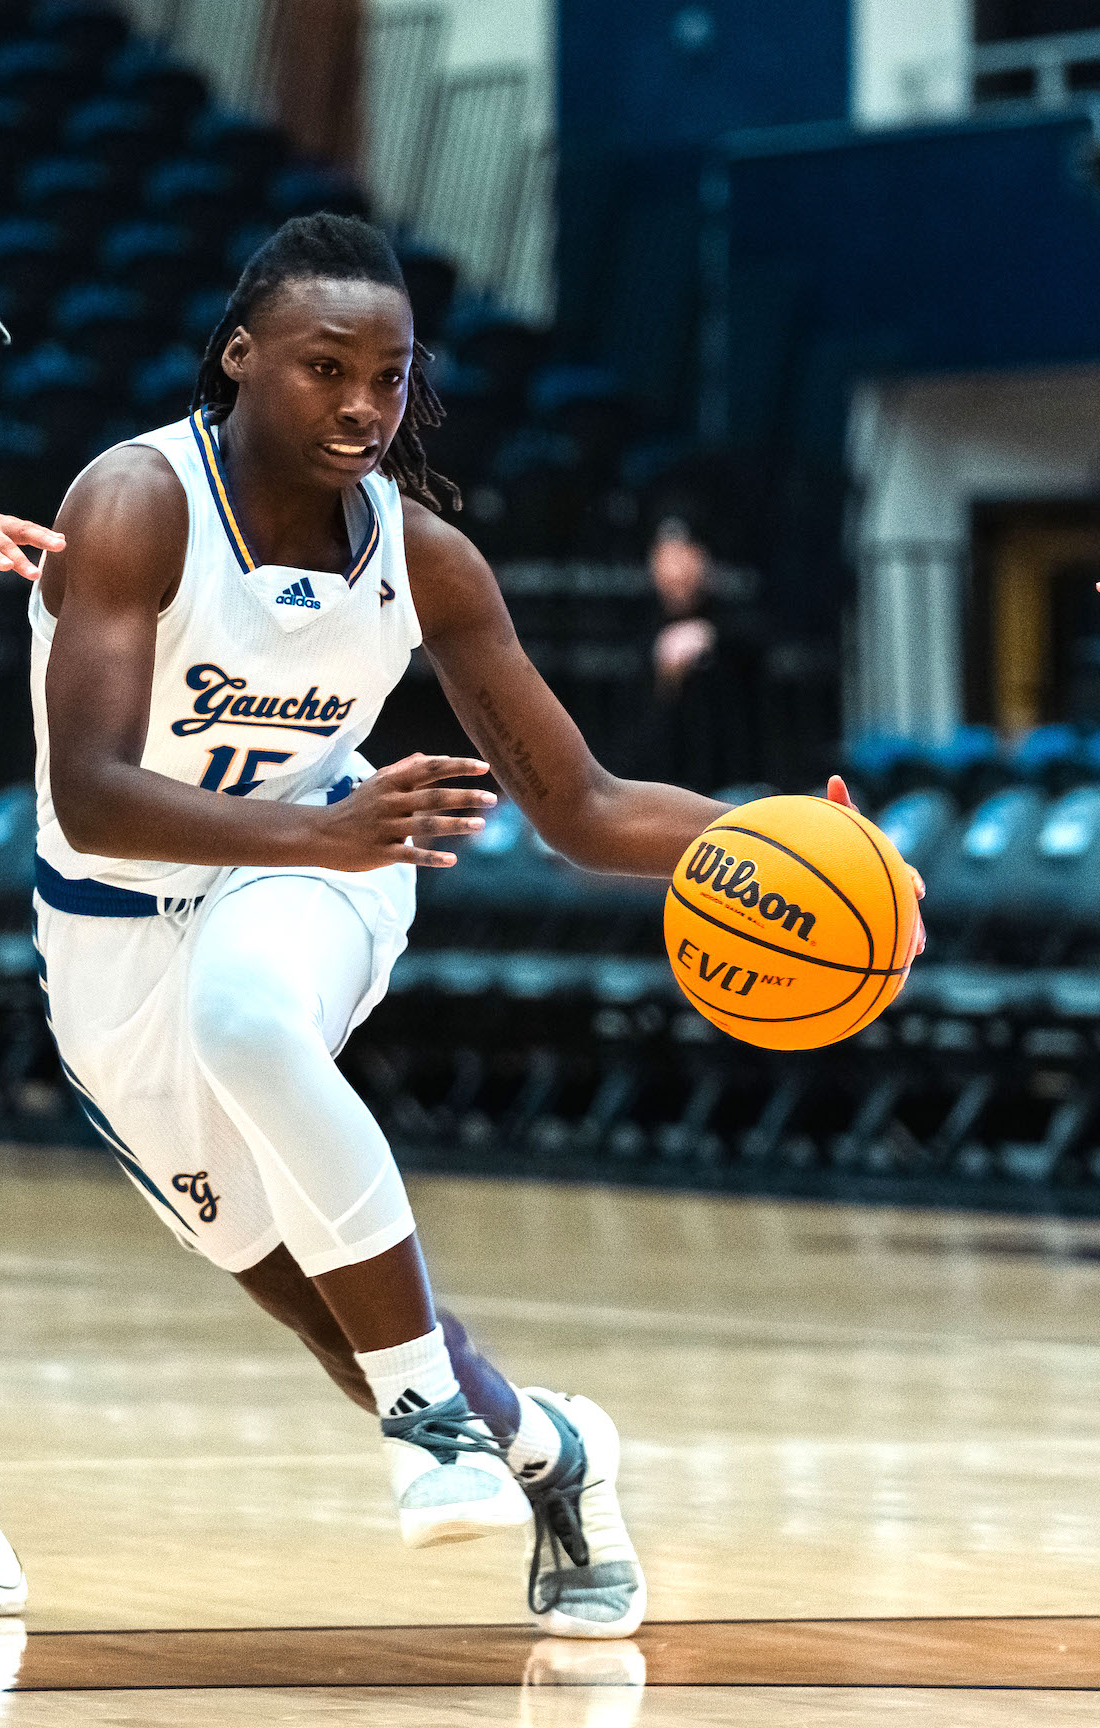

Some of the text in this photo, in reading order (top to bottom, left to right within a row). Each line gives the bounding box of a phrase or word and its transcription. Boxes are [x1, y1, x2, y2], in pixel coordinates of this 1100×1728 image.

[275, 594, 321, 610] adidas
[171, 662, 358, 738] Gauchos
[685, 841, 817, 943] Wilson
[760, 974, 797, 988] NXT
